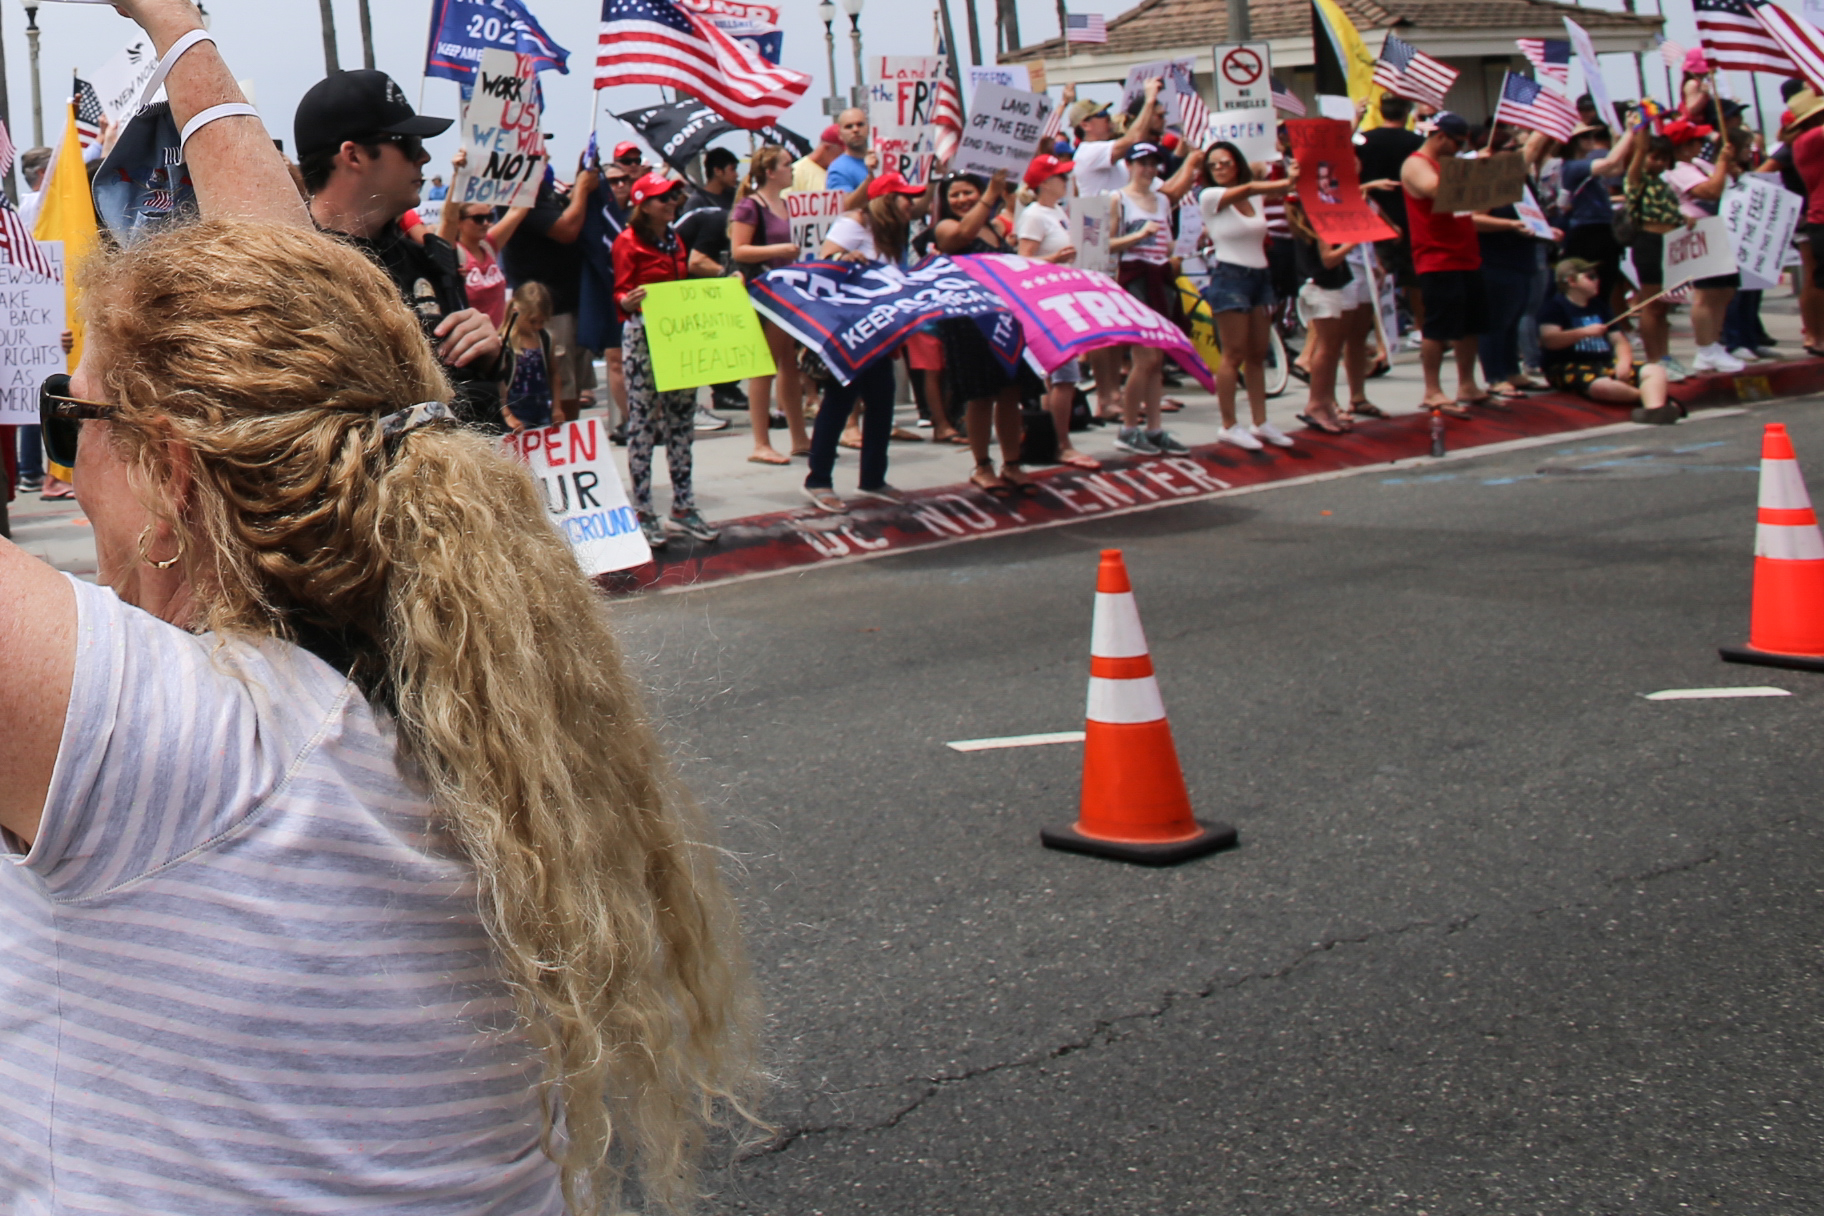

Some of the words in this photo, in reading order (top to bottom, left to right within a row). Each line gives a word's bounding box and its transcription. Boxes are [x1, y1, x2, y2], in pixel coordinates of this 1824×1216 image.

[881, 56, 926, 80] Land
[481, 71, 527, 102] WORK
[870, 85, 894, 102] the
[1001, 96, 1032, 116] LAND
[1225, 98, 1268, 109] VEHICLES
[472, 123, 511, 152] WE
[663, 119, 704, 157] DONT
[972, 113, 990, 130] OF
[992, 117, 1014, 135] THE
[1014, 122, 1039, 141] FREE
[482, 150, 542, 182] NOT
[1727, 199, 1743, 233] LAND
[1742, 222, 1758, 245] THE
[1737, 245, 1750, 264] OF
[679, 286, 696, 302] DO
[701, 286, 722, 300] NOT
[9, 308, 53, 327] BACK
[841, 304, 899, 350] KEEP
[4, 344, 60, 367] RIGHTS
[680, 345, 757, 379] HEALTHY
[11, 369, 35, 386] AS
[540, 471, 601, 515] UR
[1038, 456, 1231, 513] ENTER
[561, 505, 640, 545] GROUND
